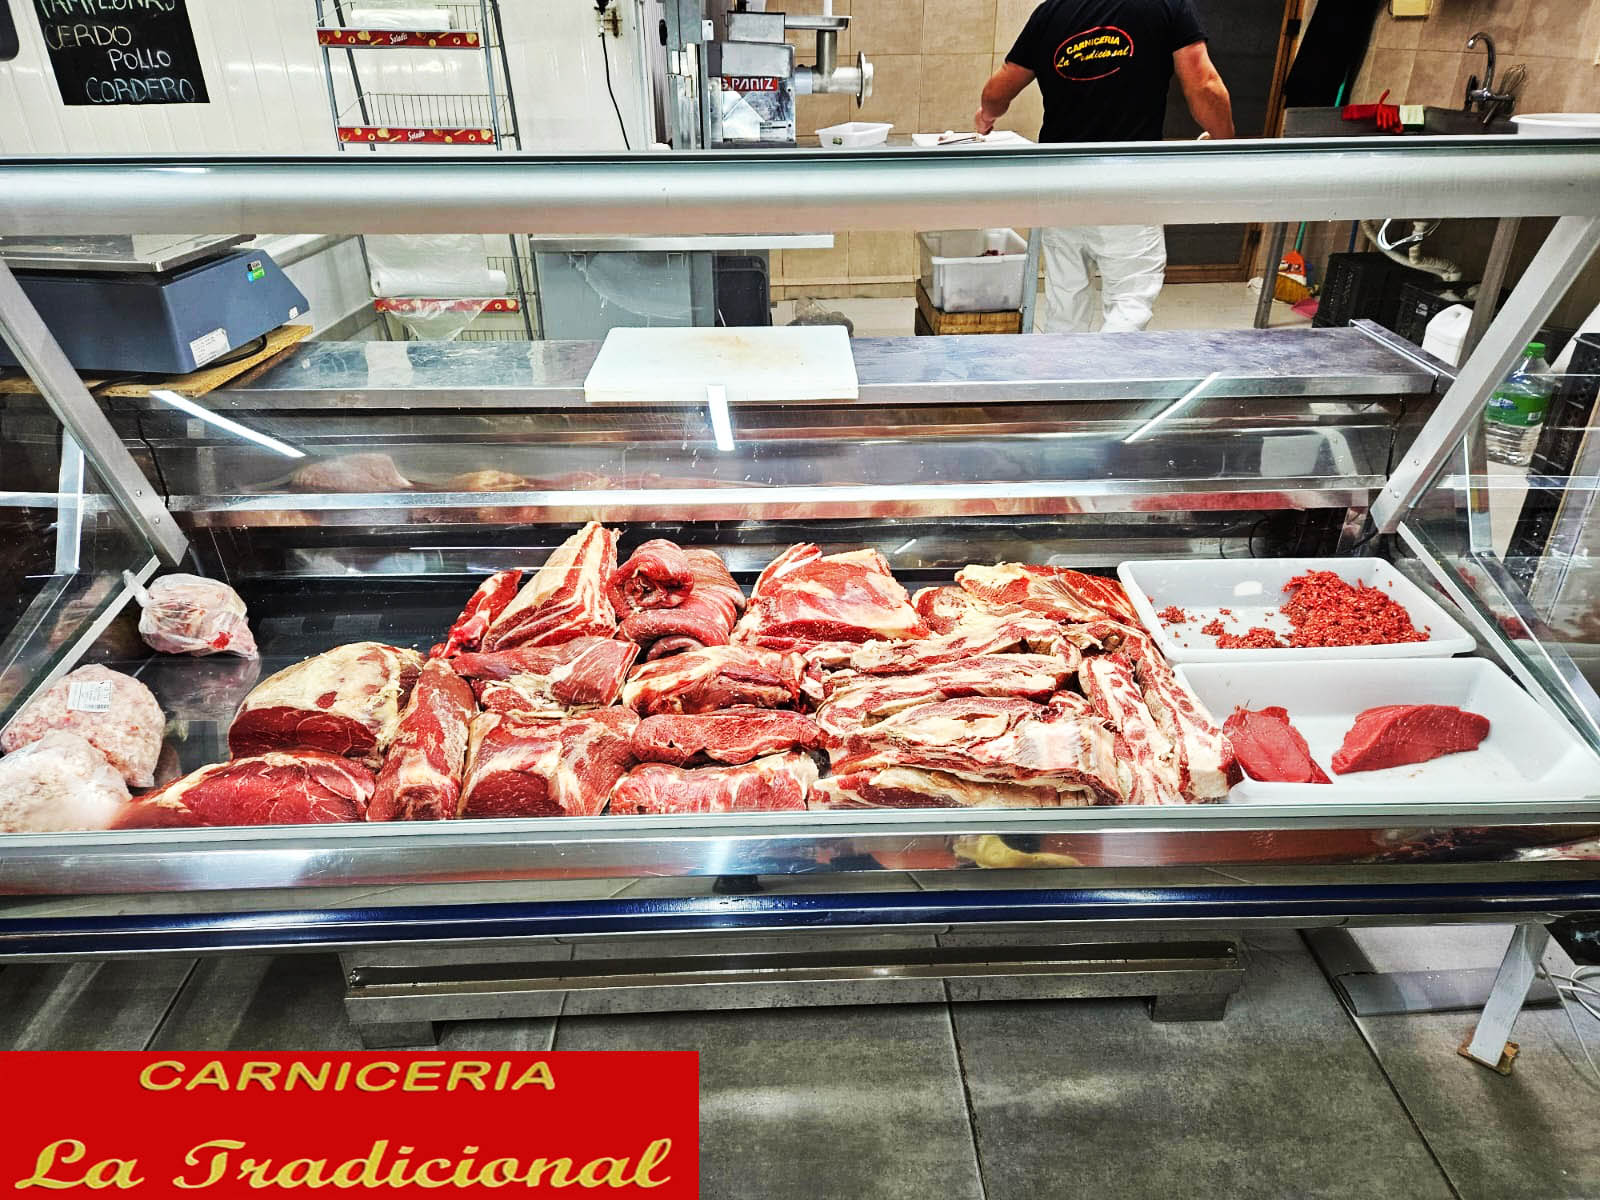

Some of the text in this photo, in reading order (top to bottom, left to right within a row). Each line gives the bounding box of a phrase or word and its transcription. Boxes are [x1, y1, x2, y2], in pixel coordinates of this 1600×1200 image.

[47, 24, 131, 49] CERDO
[1066, 35, 1120, 55] CARNICERIA
[107, 48, 171, 71] POLLO
[86, 77, 195, 102] CORDERO
